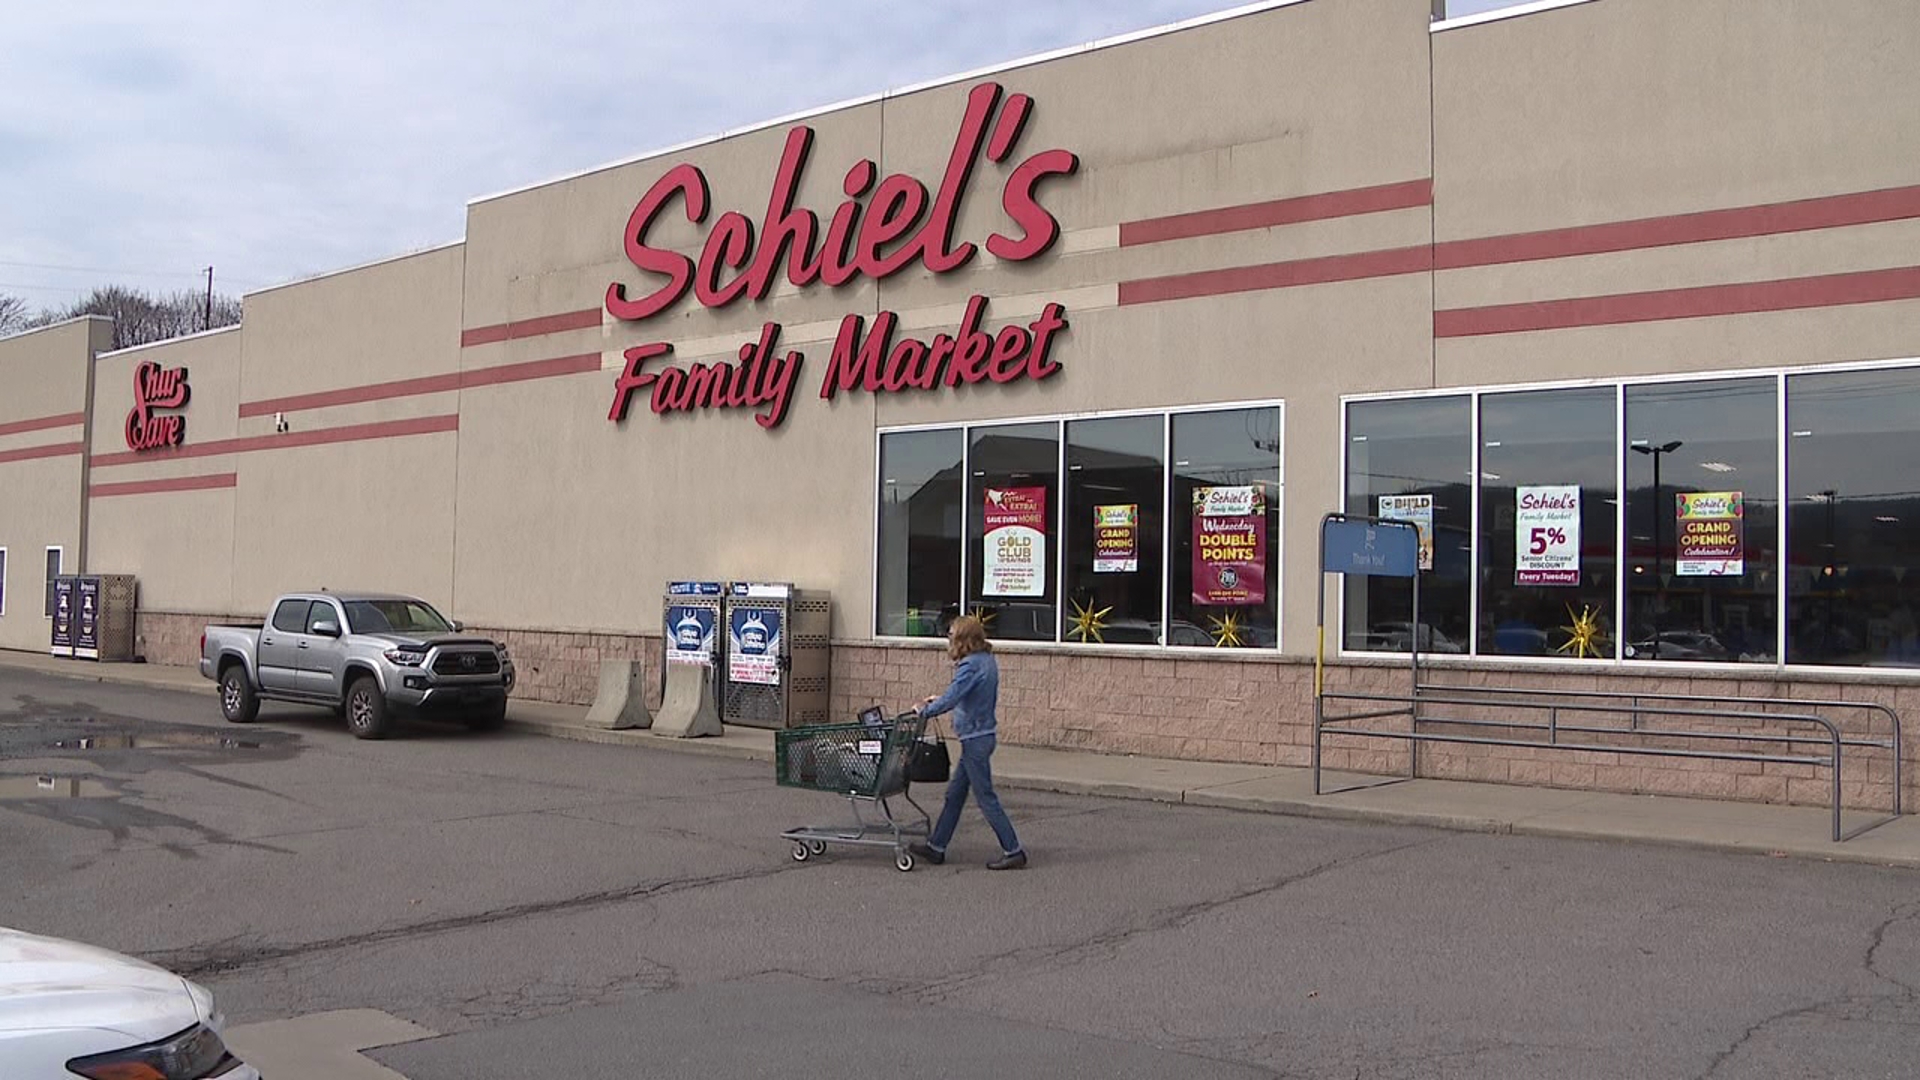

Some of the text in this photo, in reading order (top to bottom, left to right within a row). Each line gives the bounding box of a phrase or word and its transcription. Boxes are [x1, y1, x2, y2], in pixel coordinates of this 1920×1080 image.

[605, 82, 1079, 321] Schiel's
[608, 294, 1069, 429] Family Market
[134, 361, 191, 409] Shur
[125, 405, 186, 451] Save
[1210, 490, 1249, 504] Schiel's
[1520, 493, 1576, 510] Schiel's
[1692, 498, 1728, 509] Schiel's
[1520, 513, 1544, 522] Family
[1203, 518, 1255, 535] Wednesday
[1687, 522, 1731, 533] GRAND
[1100, 529, 1130, 538] GRAND
[997, 536, 1032, 547] GOLD
[1097, 538, 1134, 548] OPENING
[1200, 534, 1256, 546] DOUBLE
[1530, 527, 1566, 555] 5%
[1681, 534, 1737, 545] OPENING
[997, 547, 1032, 558] CLUB
[1203, 548, 1254, 560] POINTS
[1684, 547, 1735, 556] Celebration!
[1519, 572, 1576, 582] Every Tuesday!
